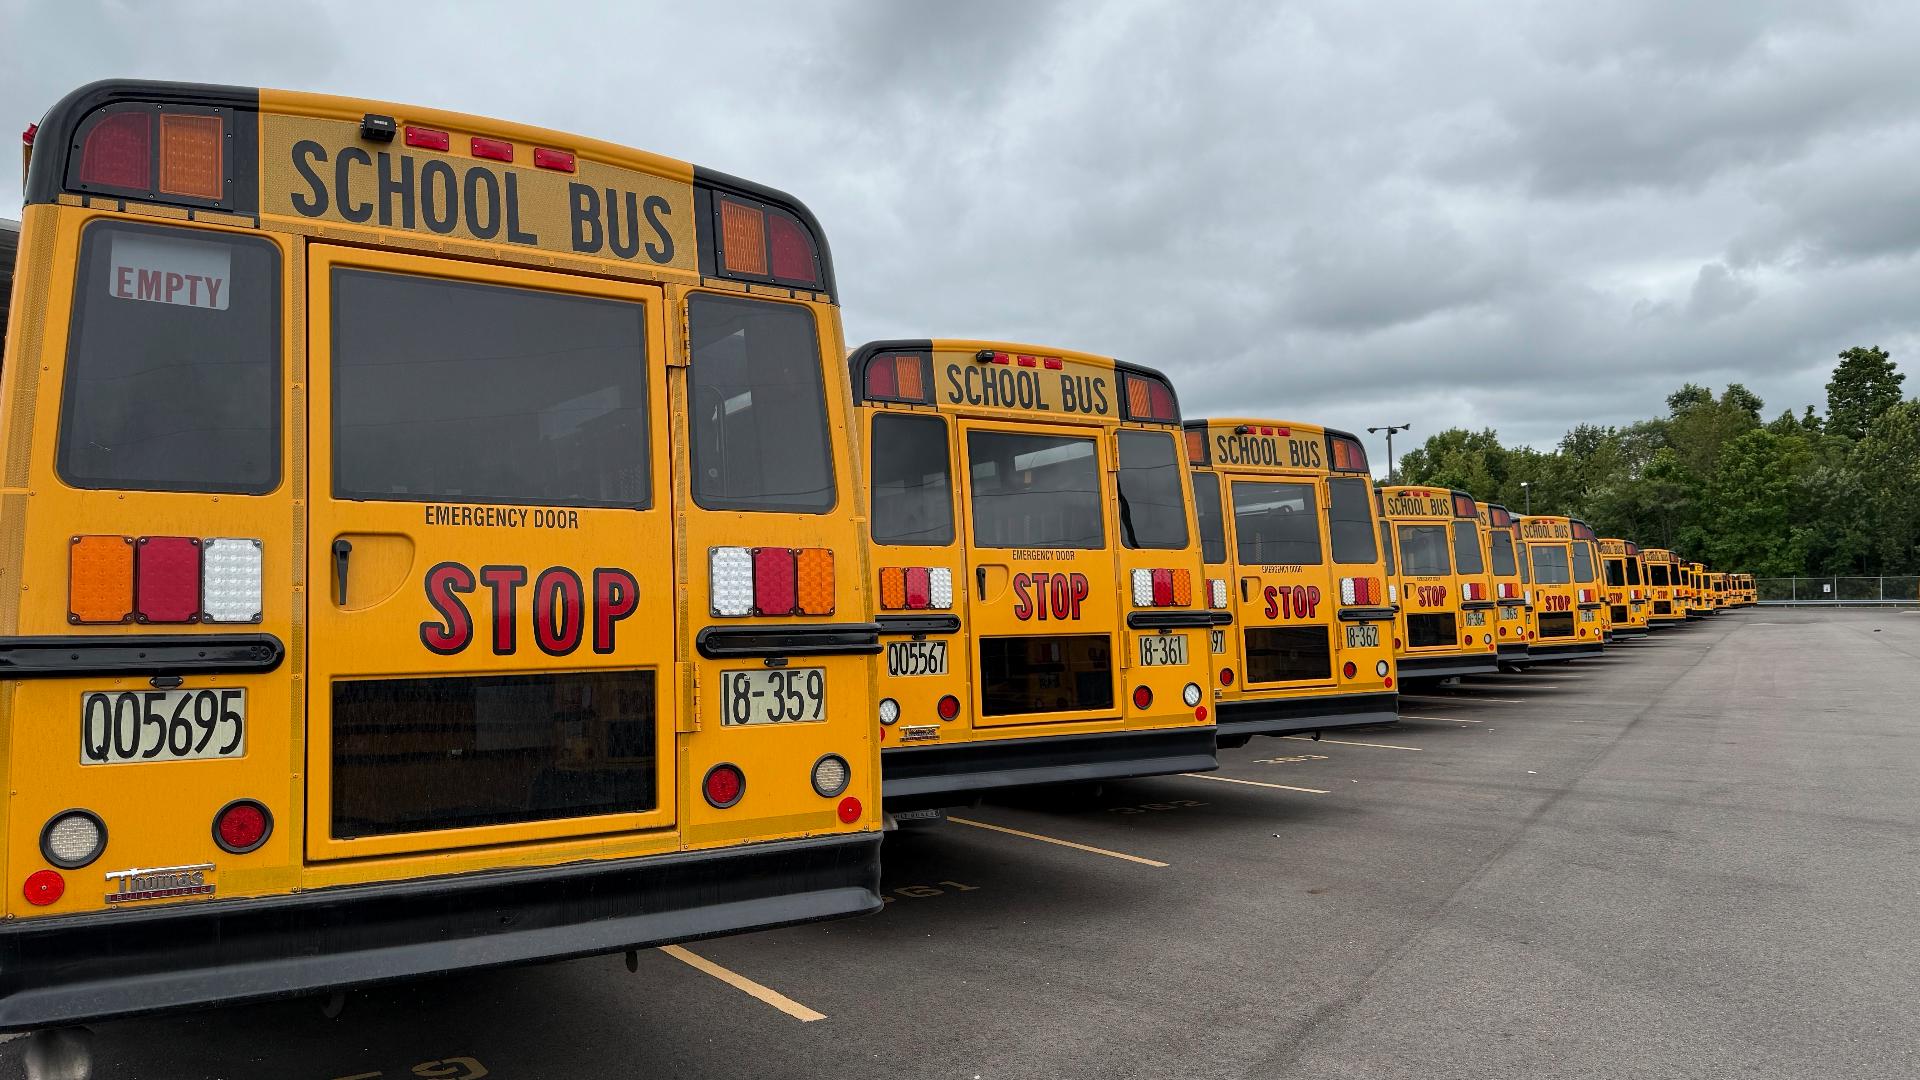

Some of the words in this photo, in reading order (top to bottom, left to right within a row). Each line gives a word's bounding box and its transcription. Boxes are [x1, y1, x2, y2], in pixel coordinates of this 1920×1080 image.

[290, 139, 538, 246] SCHOOL
[568, 181, 675, 265] BUS
[117, 266, 223, 308] EMPTY
[946, 363, 1050, 411] SCHOOL
[1061, 374, 1109, 415] BUS
[1216, 435, 1283, 466] SCHOOL
[1288, 439, 1321, 468] BUS
[425, 505, 529, 528] EMERGENCY
[534, 509, 579, 529] DOOR
[1387, 497, 1427, 516] SCHOOL
[1429, 498, 1450, 516] BUS
[1523, 524, 1553, 539] SCHOOL
[1554, 525, 1569, 539] BUS
[1012, 549, 1054, 561] EMERGENCY
[1056, 550, 1075, 561] DOOR
[420, 561, 640, 657] STOP
[1013, 572, 1089, 621] STOP
[1263, 585, 1321, 619] STOP
[1417, 585, 1447, 607] STOP
[1545, 594, 1571, 611] STOP
[1140, 635, 1183, 666] 18-361
[1346, 626, 1379, 648] 18-362
[889, 642, 946, 676] Q05567
[723, 669, 824, 725] 18-359
[85, 690, 243, 763] Q05695
[105, 863, 216, 893] Thomas
[116, 892, 155, 900] BUILT
[161, 886, 207, 896] BUSES
